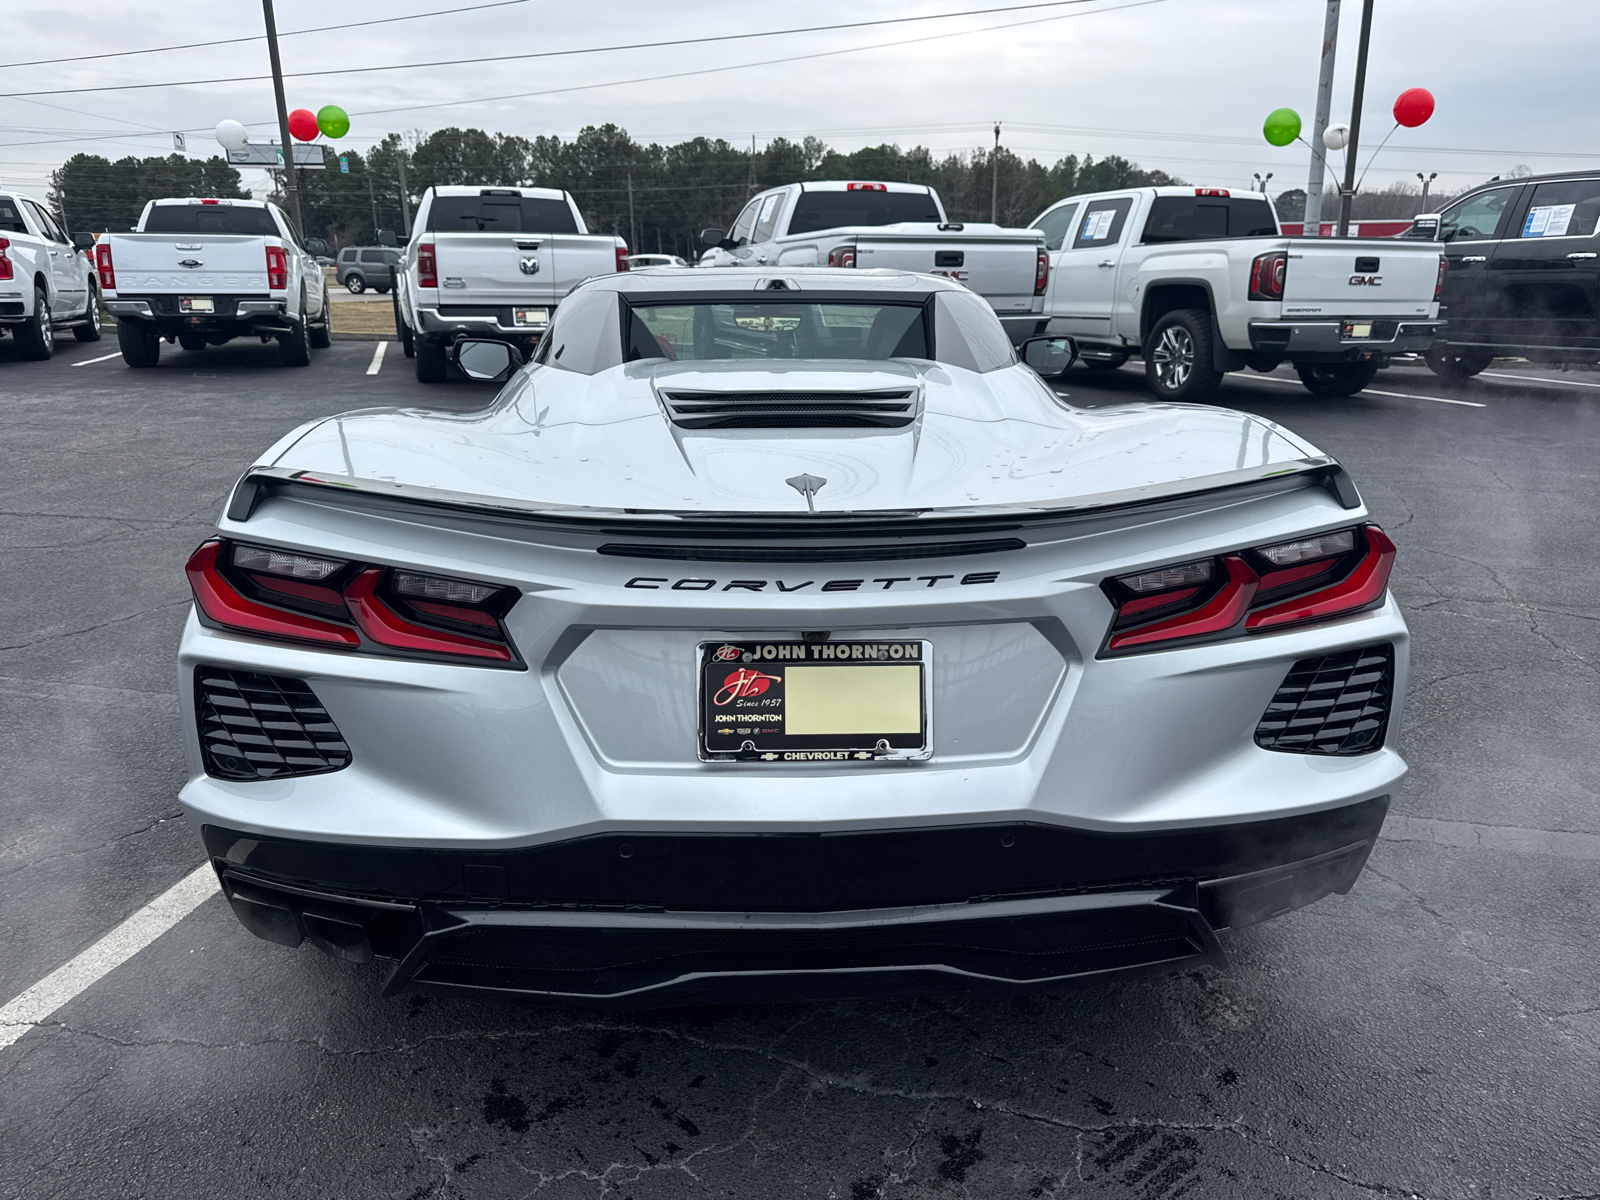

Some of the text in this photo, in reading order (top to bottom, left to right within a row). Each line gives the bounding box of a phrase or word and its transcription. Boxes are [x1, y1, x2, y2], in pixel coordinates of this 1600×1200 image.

[119, 276, 264, 286] RANGER
[1348, 275, 1383, 286] GMC
[623, 571, 1001, 592] CORVETTE
[752, 644, 808, 660] JOHN
[736, 698, 782, 708] Since 1957
[715, 713, 782, 723] JOHN THORNTON
[784, 751, 850, 761] CHEVROLET
